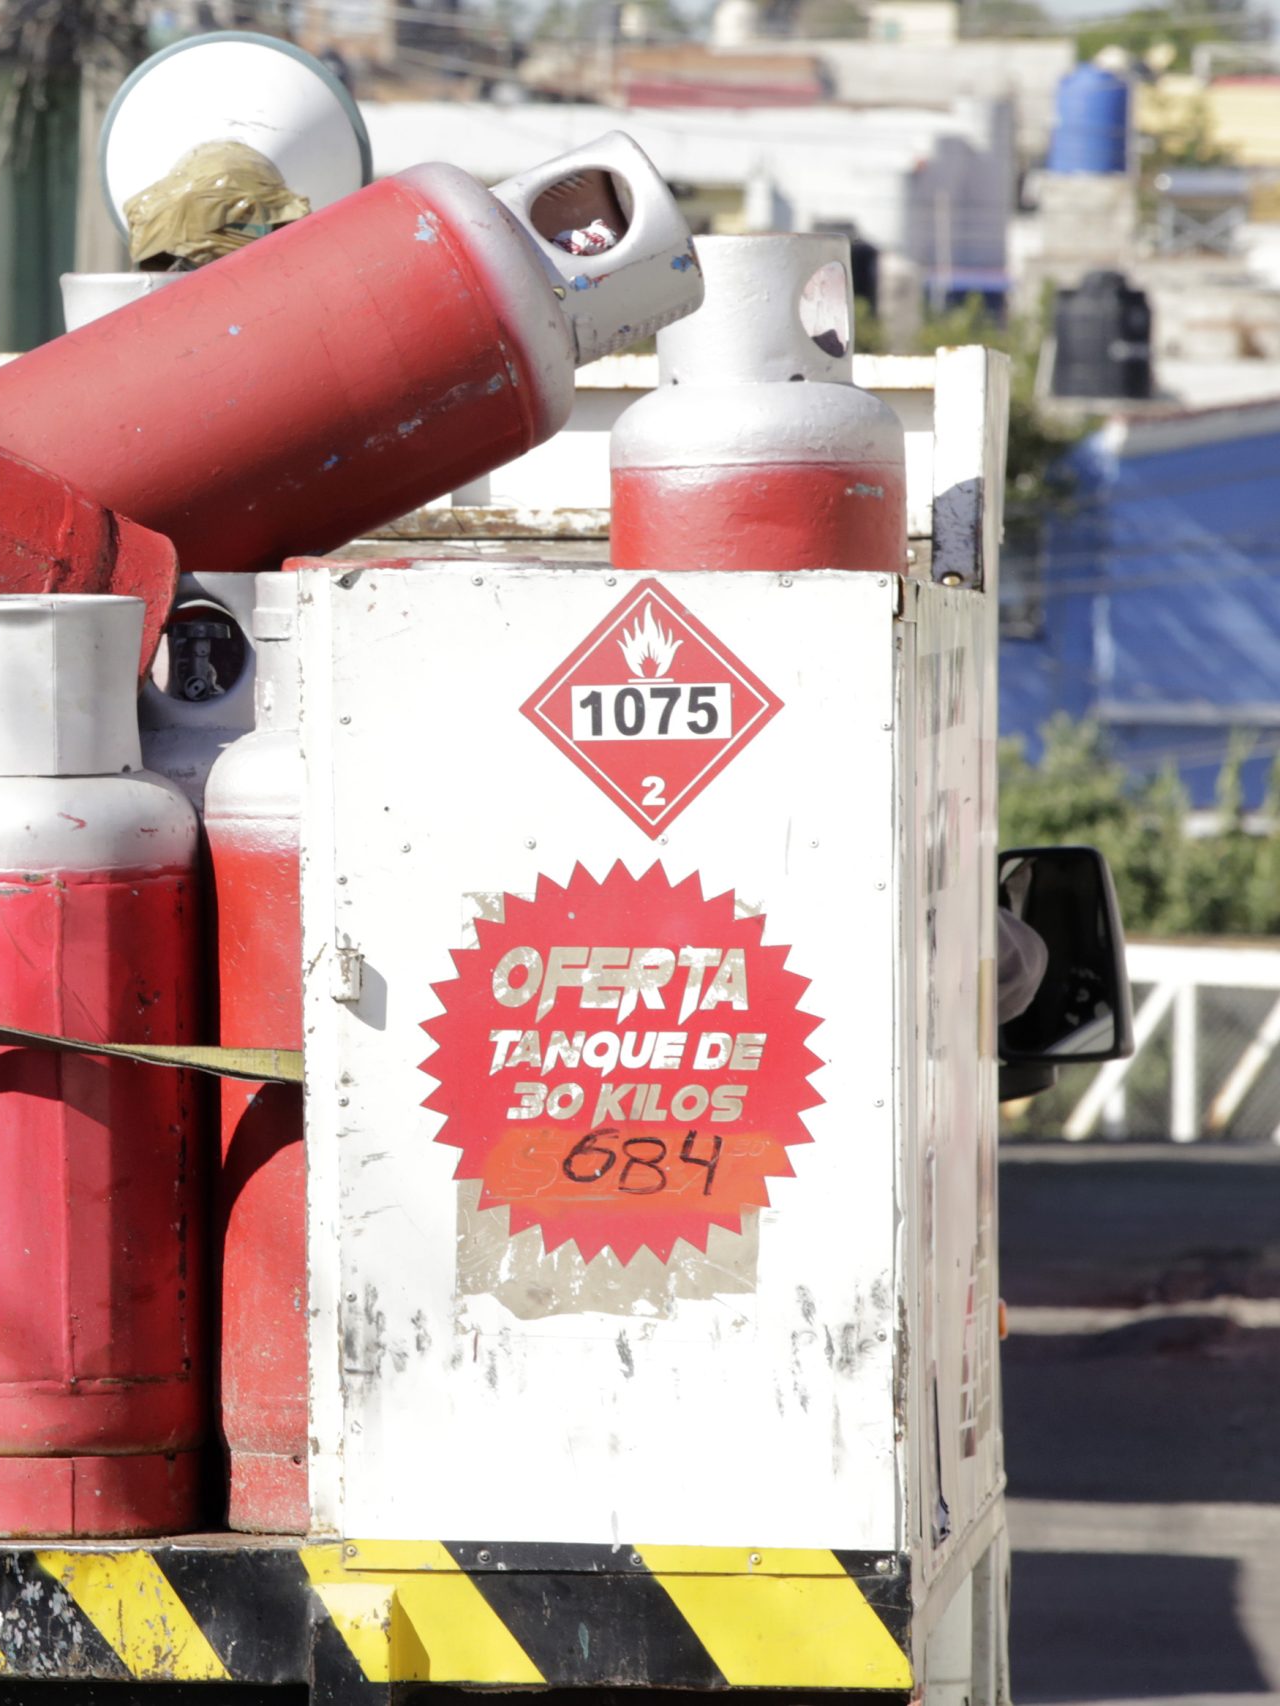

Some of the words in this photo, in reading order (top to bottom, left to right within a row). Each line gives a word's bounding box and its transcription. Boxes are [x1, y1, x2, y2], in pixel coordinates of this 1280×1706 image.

[579, 686, 719, 737] 1075
[641, 775, 667, 806] 2
[492, 946, 749, 1025] OFERTA
[489, 1029, 688, 1077] TANQUE
[692, 1032, 767, 1071] DE
[506, 1082, 584, 1120] 30
[591, 1083, 748, 1129] KILOS
[563, 1128, 722, 1196] 684
